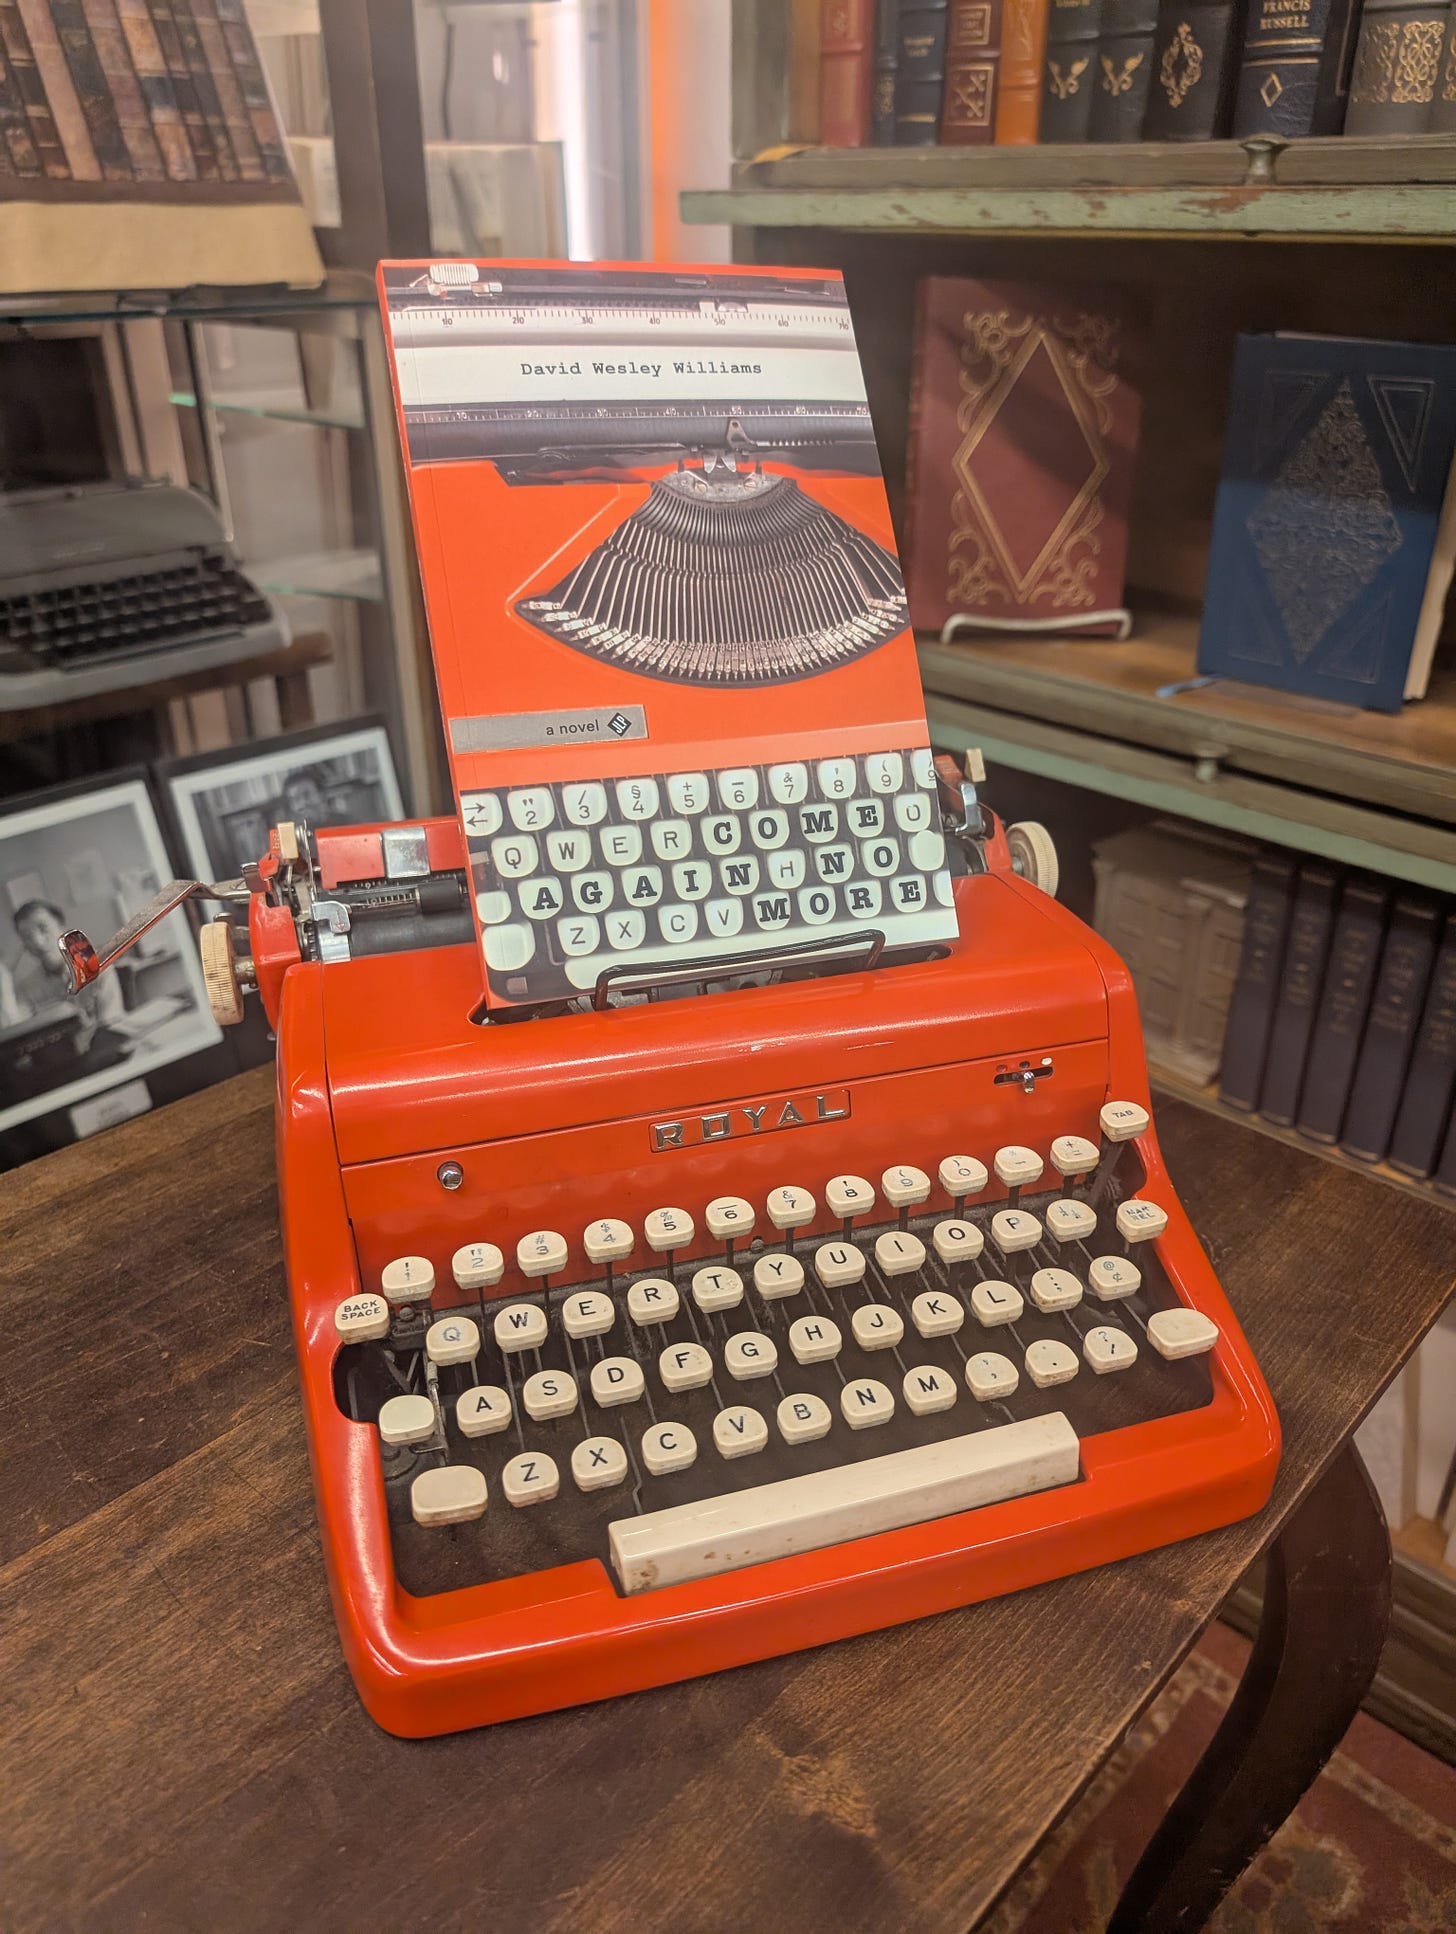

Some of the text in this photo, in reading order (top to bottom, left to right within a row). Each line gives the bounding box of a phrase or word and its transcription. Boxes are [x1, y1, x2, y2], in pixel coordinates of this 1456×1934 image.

[1260, 15, 1309, 30] RUSSELL
[521, 362, 762, 377] David Wesley Williams
[546, 719, 600, 736] a novel
[526, 811, 537, 825] 2
[579, 805, 590, 819] 3
[633, 801, 644, 814] 4
[684, 795, 695, 808] 5
[734, 790, 745, 803] 6
[785, 784, 794, 798] 7
[834, 780, 844, 792] 8
[881, 774, 891, 787] 9
[504, 847, 522, 869] Q
[559, 842, 576, 860] W
[612, 836, 629, 854] E
[664, 831, 679, 849] R
[780, 861, 794, 878] H
[570, 927, 586, 945] Z
[618, 921, 632, 939] X
[670, 915, 685, 932] C
[718, 909, 729, 926] V
[654, 1094, 846, 1150] ROYAL
[472, 1257, 484, 1268] 2
[536, 1245, 549, 1255] 3
[603, 1233, 616, 1243] 4
[664, 1221, 677, 1231] 5
[724, 1210, 738, 1219] 6
[785, 1199, 798, 1209] 7
[845, 1188, 858, 1198] 8
[901, 1178, 914, 1187] 9
[442, 1327, 461, 1342] Q
[508, 1312, 529, 1329] W
[579, 1300, 597, 1316] E
[643, 1287, 662, 1302] R
[707, 1274, 722, 1289] T
[769, 1262, 783, 1276] Y
[829, 1249, 847, 1264] U
[893, 1240, 904, 1253] I
[948, 1227, 966, 1240] O
[1006, 1217, 1020, 1230] P
[341, 1306, 381, 1320] SPACE
[343, 1300, 378, 1313] BACK
[475, 1396, 493, 1412] A
[542, 1380, 558, 1397] S
[608, 1366, 625, 1384] D
[676, 1351, 691, 1369] F
[741, 1341, 759, 1358] G
[805, 1324, 824, 1342] H
[870, 1313, 884, 1328] J
[926, 1300, 947, 1315] K
[987, 1290, 1006, 1303] L
[520, 1462, 539, 1482] Z
[589, 1447, 609, 1467] X
[659, 1432, 678, 1450] C
[729, 1416, 745, 1434] V
[793, 1403, 813, 1420] B
[856, 1387, 877, 1406] N
[917, 1375, 941, 1393] M
